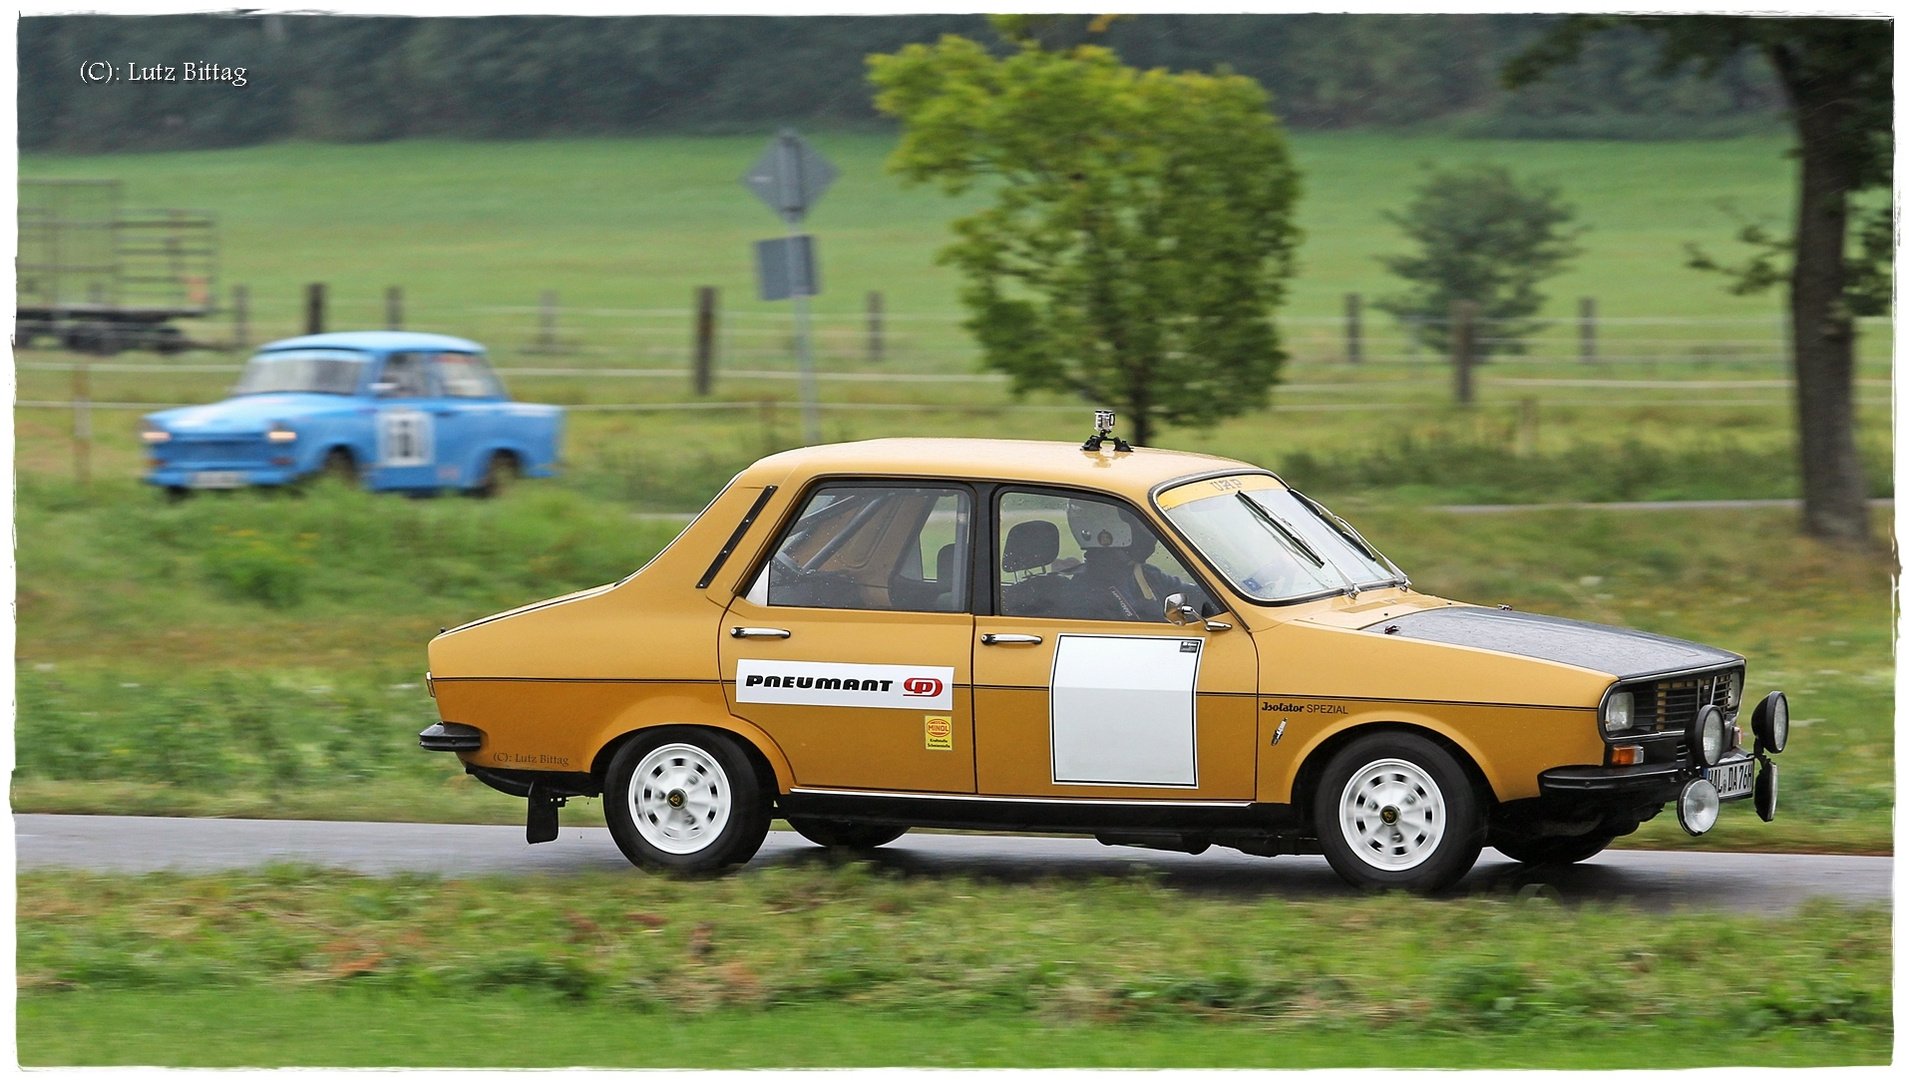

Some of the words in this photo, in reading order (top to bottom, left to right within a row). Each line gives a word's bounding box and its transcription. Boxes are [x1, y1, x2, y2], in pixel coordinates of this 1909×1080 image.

[745, 675, 894, 692] PNEUMANT
[1306, 703, 1349, 715] SPEZIAL
[928, 724, 950, 732] MINOL
